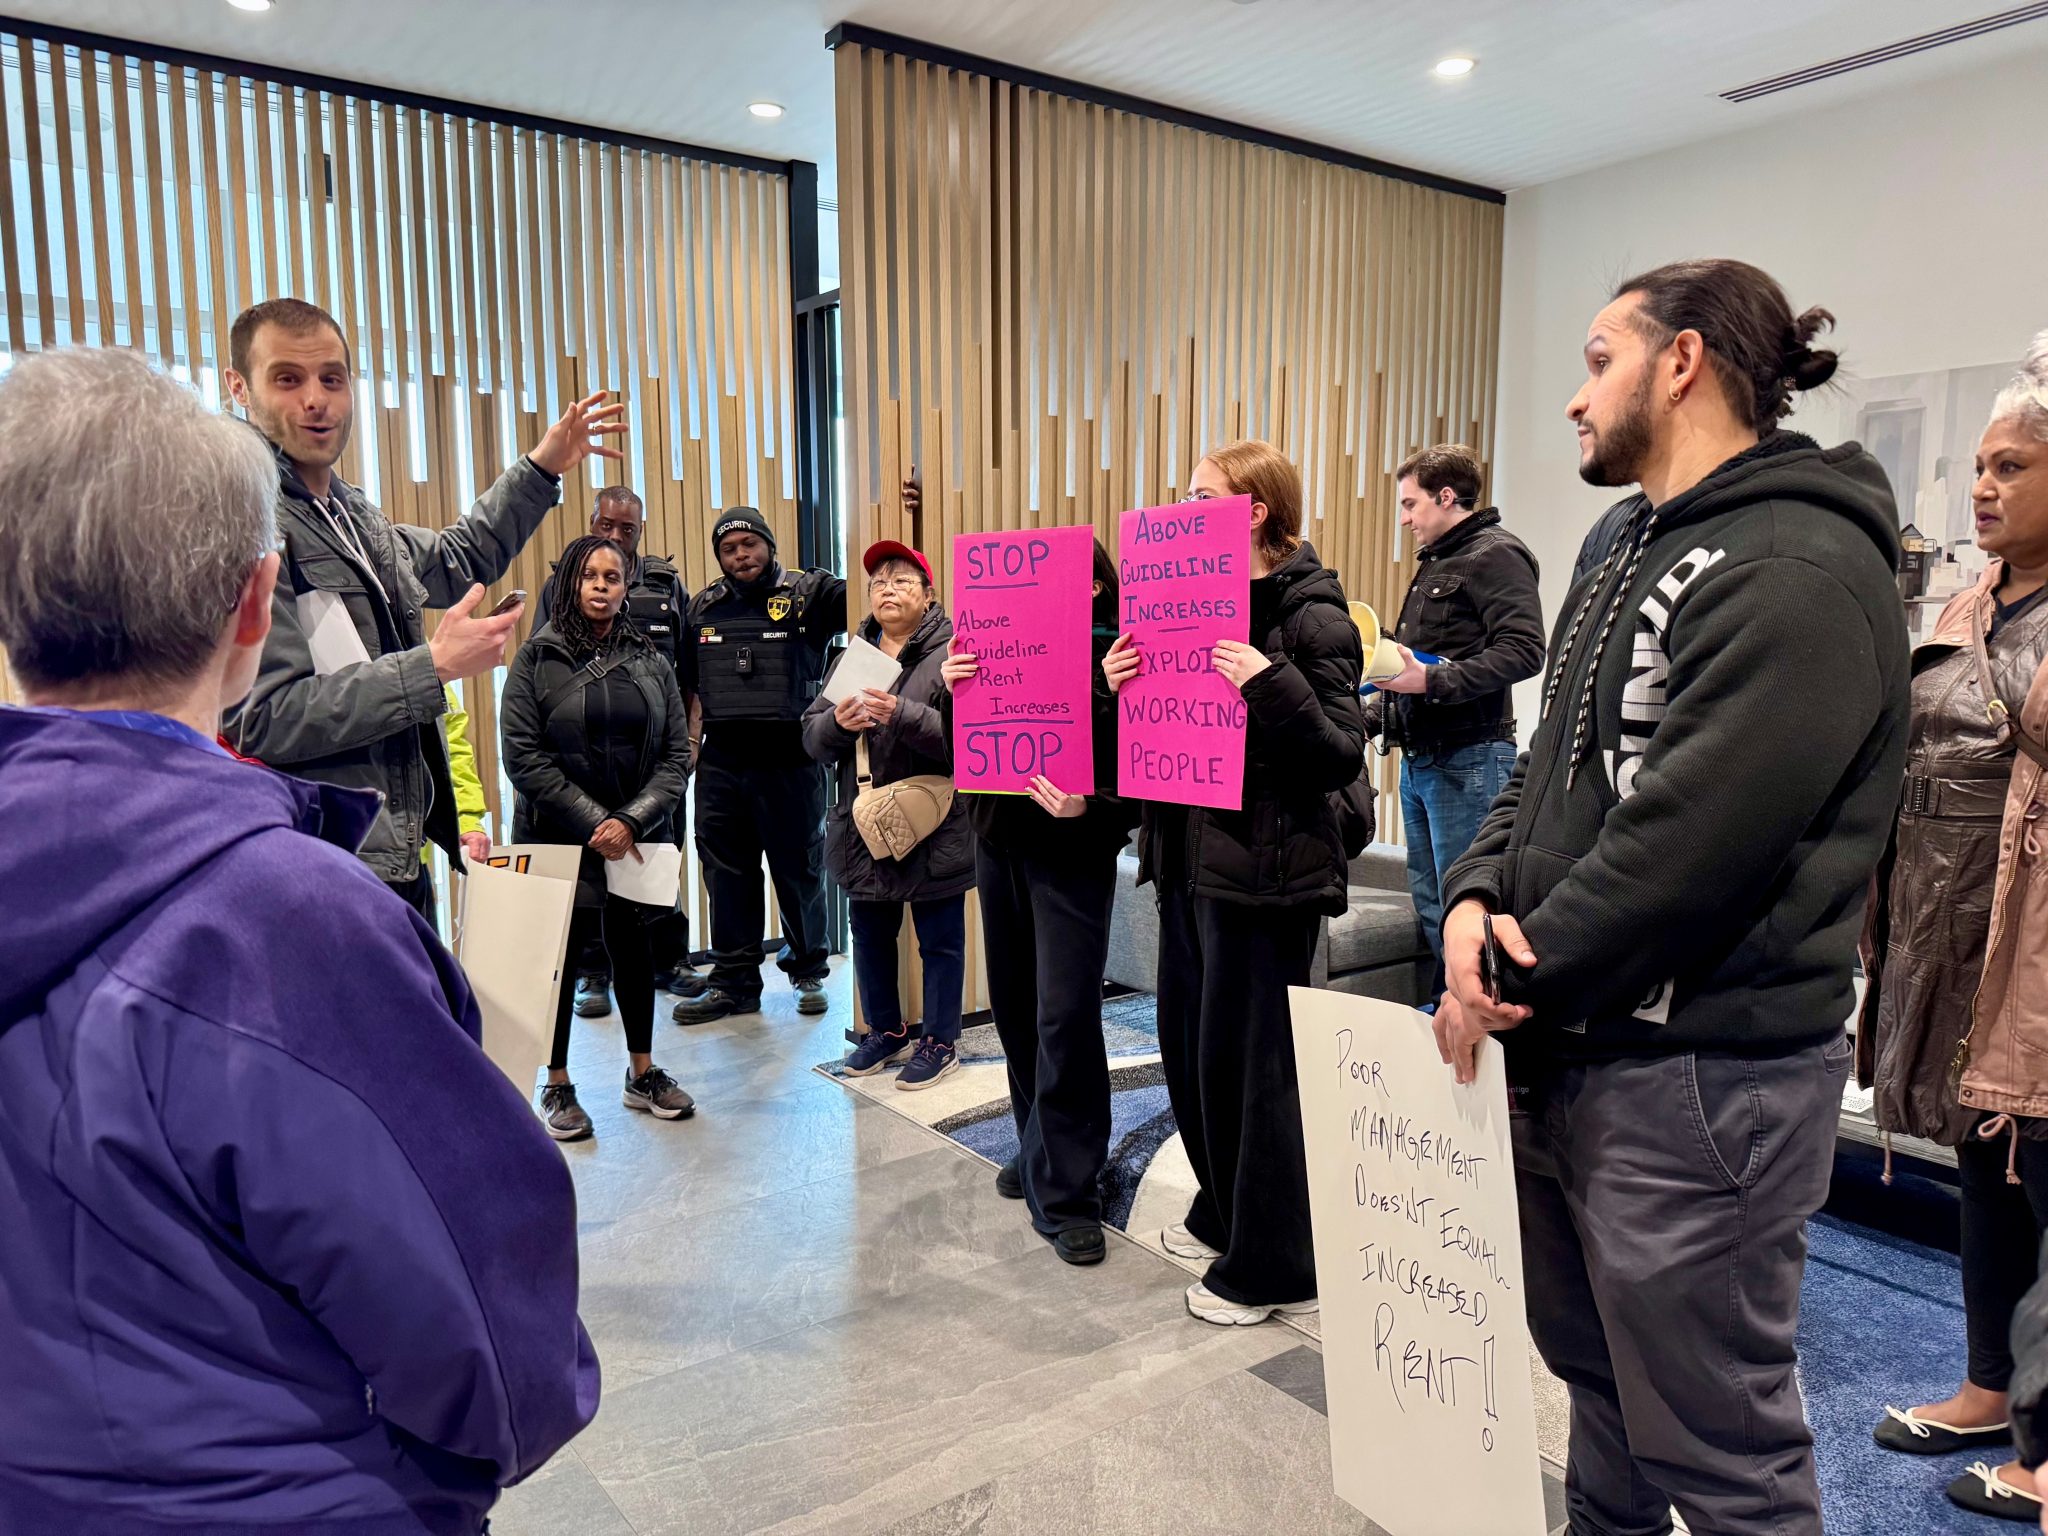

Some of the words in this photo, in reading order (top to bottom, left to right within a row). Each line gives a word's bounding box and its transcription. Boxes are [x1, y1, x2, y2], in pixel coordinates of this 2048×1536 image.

[717, 520, 752, 536] SECURITY
[1134, 511, 1206, 545] ABOVE
[966, 539, 1050, 581] STOP
[1120, 553, 1233, 587] GUIDELINE
[957, 608, 1011, 632] Above
[1124, 595, 1236, 624] INCREASES
[762, 631, 788, 639] SECURITY
[964, 637, 1048, 660] Guideline
[1129, 641, 1218, 677] XPLOI
[979, 666, 1024, 687] Rent
[989, 697, 1070, 716] Increases
[1123, 696, 1247, 729] WORKING
[966, 730, 1063, 777] STOP
[1130, 741, 1224, 785] PEOPLE
[1335, 1028, 1391, 1098] POOR
[1350, 1105, 1488, 1190] MANAGEMENT
[1439, 1207, 1511, 1290] EQUAL
[1359, 1242, 1488, 1327] INCREASED
